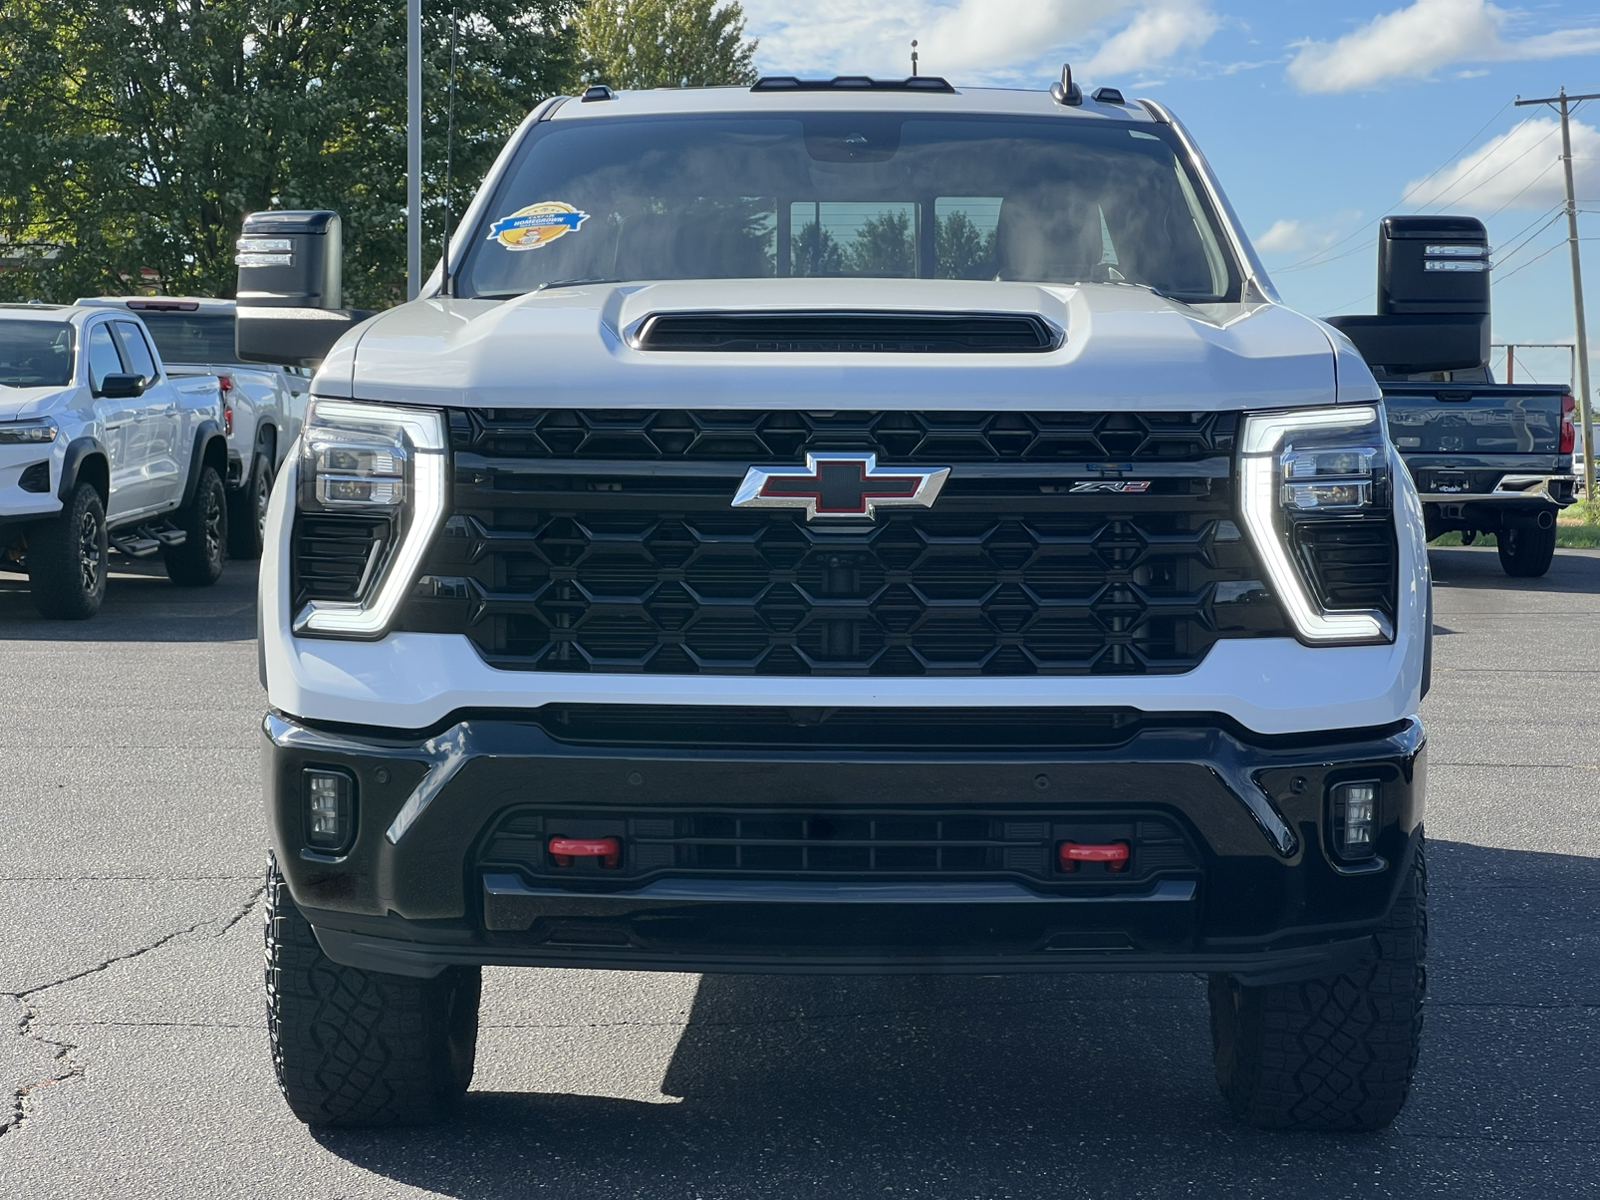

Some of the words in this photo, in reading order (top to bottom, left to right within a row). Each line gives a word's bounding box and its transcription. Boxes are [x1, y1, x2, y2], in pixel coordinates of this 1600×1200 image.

[513, 217, 564, 226] HOMEGROWN
[755, 342, 935, 351] CHEVROLET
[1068, 481, 1151, 492] ZR2
